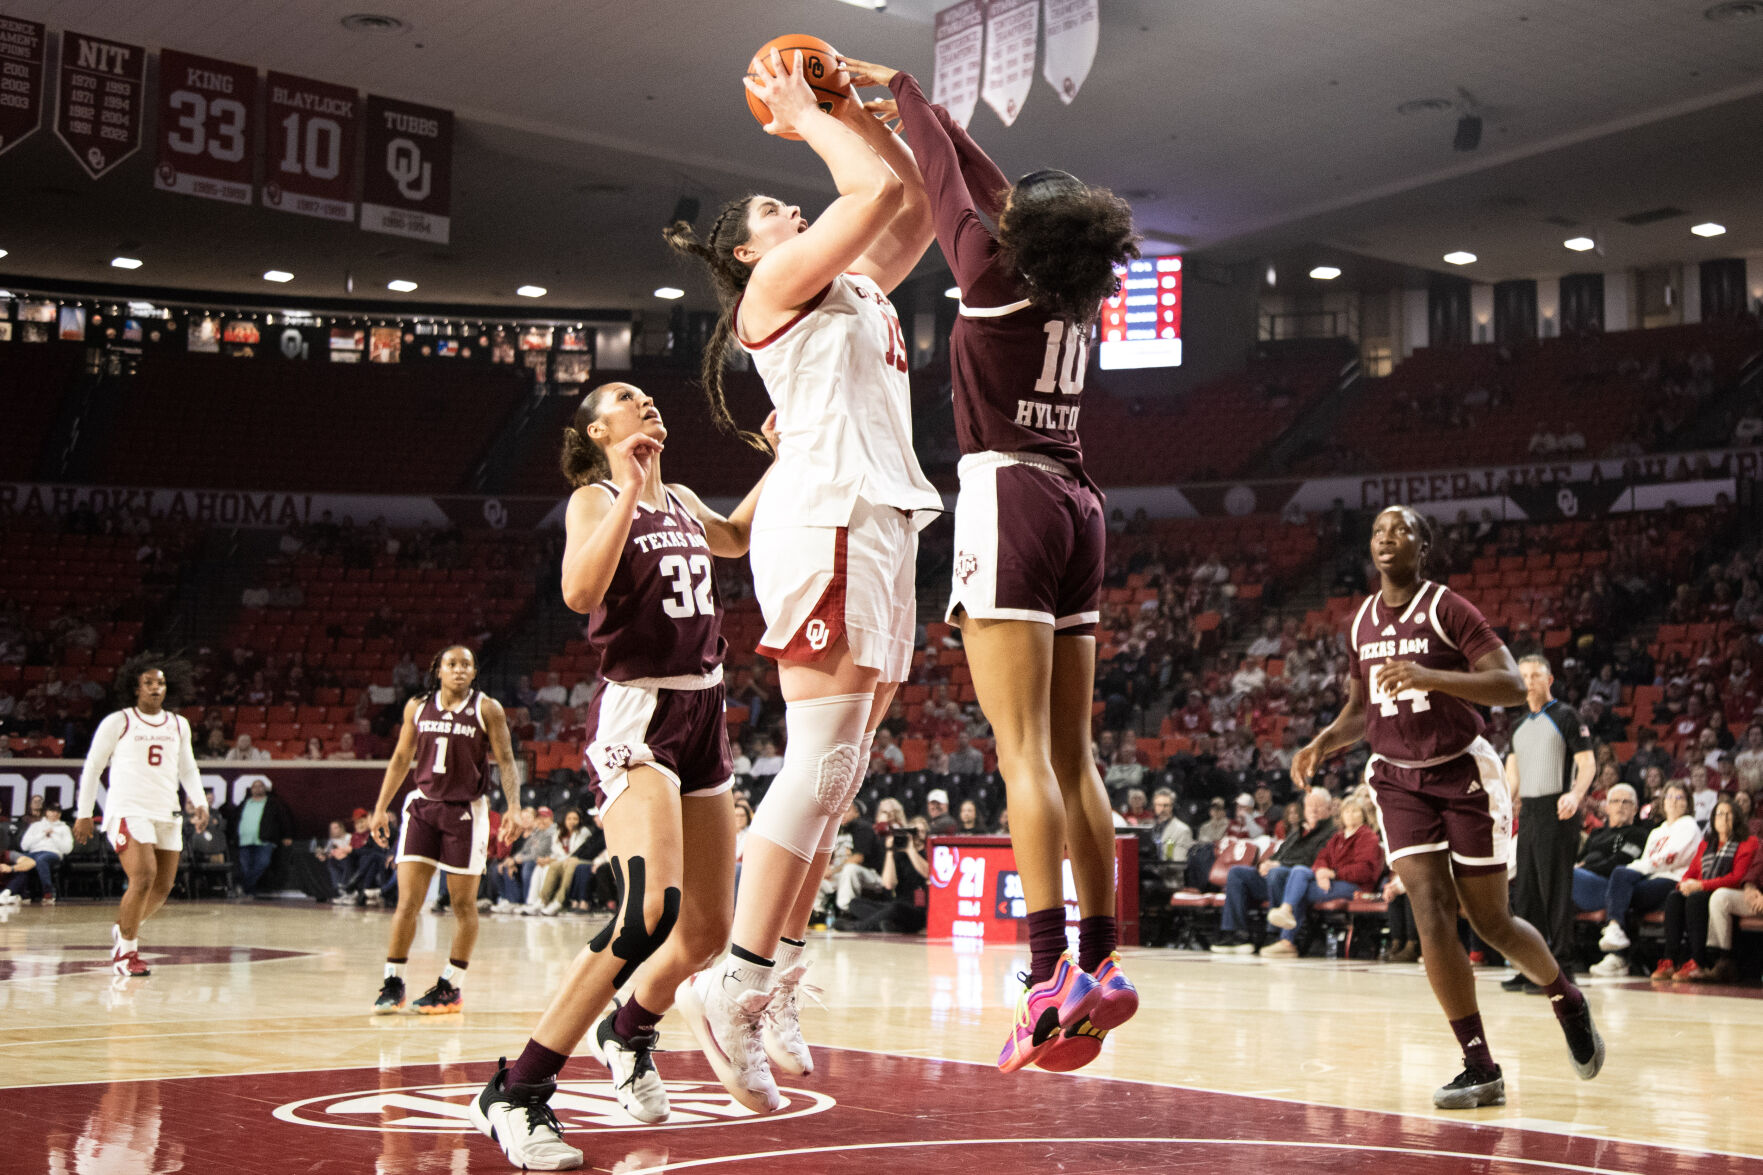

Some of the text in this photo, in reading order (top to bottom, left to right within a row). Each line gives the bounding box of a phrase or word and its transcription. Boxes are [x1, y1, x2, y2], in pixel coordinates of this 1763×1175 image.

[77, 39, 132, 75] NIT
[187, 67, 234, 94] KING
[273, 86, 353, 118] BLAYLOCK
[168, 89, 246, 162] 33
[384, 111, 439, 138] TUBBS
[280, 112, 342, 181] 10
[386, 138, 432, 200] OU
[1034, 320, 1087, 395] 10
[633, 531, 689, 553] TEXAS
[659, 554, 715, 618] 32
[805, 618, 830, 650] OU
[1359, 638, 1429, 662] TEXAS A&M
[418, 720, 452, 734] TEXAS
[148, 744, 163, 767] 6
[432, 736, 448, 774] 1
